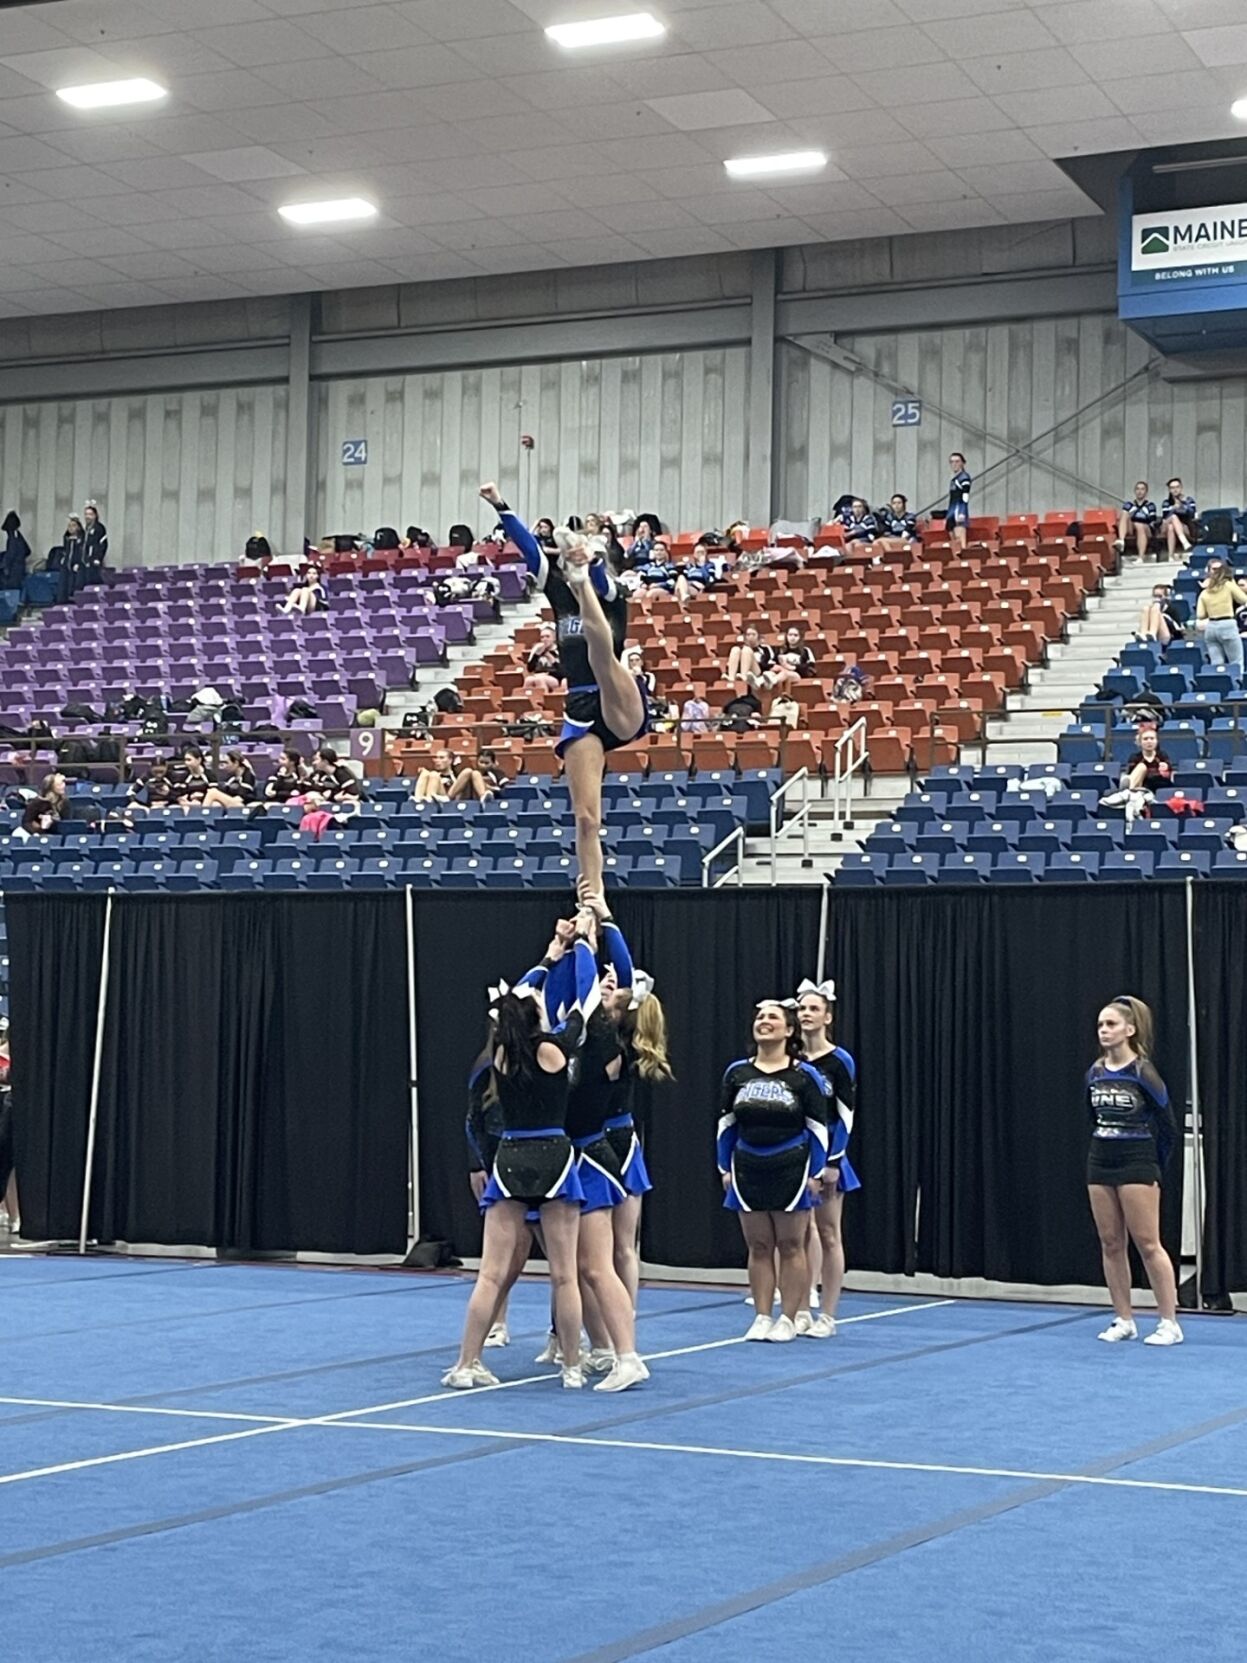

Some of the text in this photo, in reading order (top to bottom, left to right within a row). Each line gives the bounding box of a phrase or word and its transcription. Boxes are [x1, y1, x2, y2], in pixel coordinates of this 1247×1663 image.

[1173, 219, 1247, 245] MAINE
[1155, 265, 1235, 280] BELONG WITH US
[892, 403, 920, 424] 25
[343, 442, 366, 462] 24
[358, 731, 374, 756] 9
